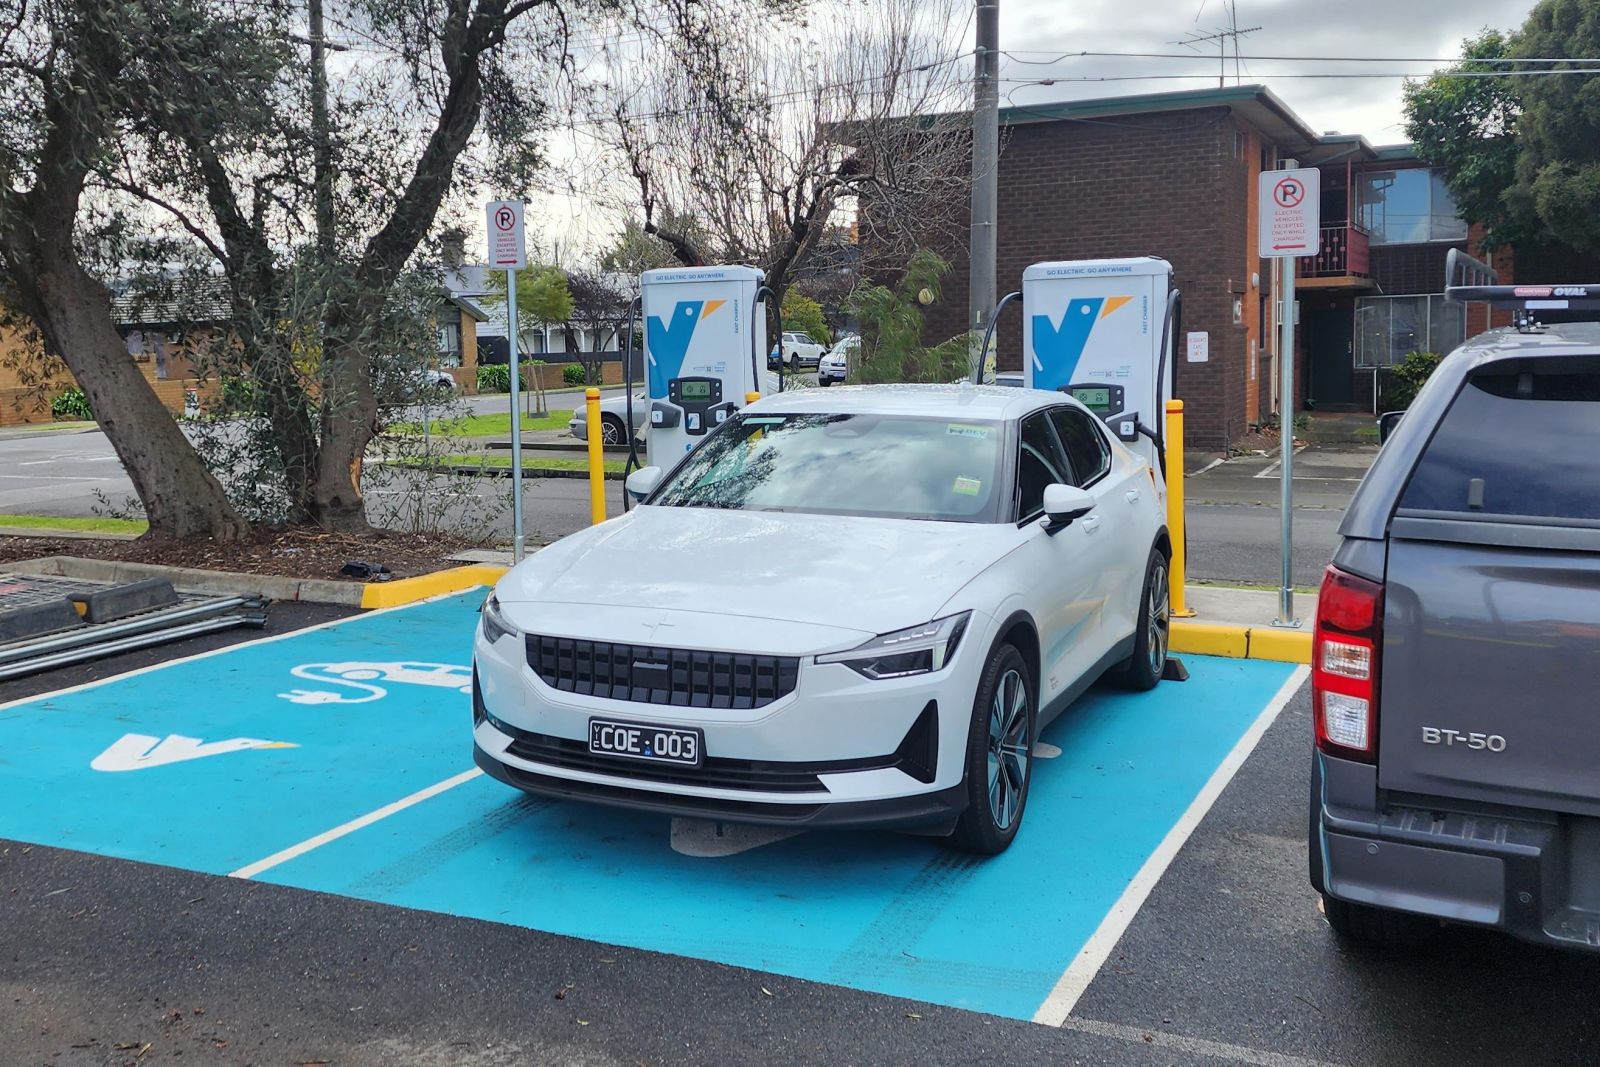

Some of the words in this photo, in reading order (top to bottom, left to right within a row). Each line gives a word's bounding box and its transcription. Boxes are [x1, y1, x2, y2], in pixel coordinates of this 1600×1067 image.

[1283, 185, 1297, 202] P
[501, 212, 510, 226] P
[1553, 287, 1588, 296] OVAL
[1124, 424, 1130, 432] 2
[601, 727, 641, 753] COE
[654, 732, 696, 759] 003
[1422, 726, 1507, 752] BT-50
